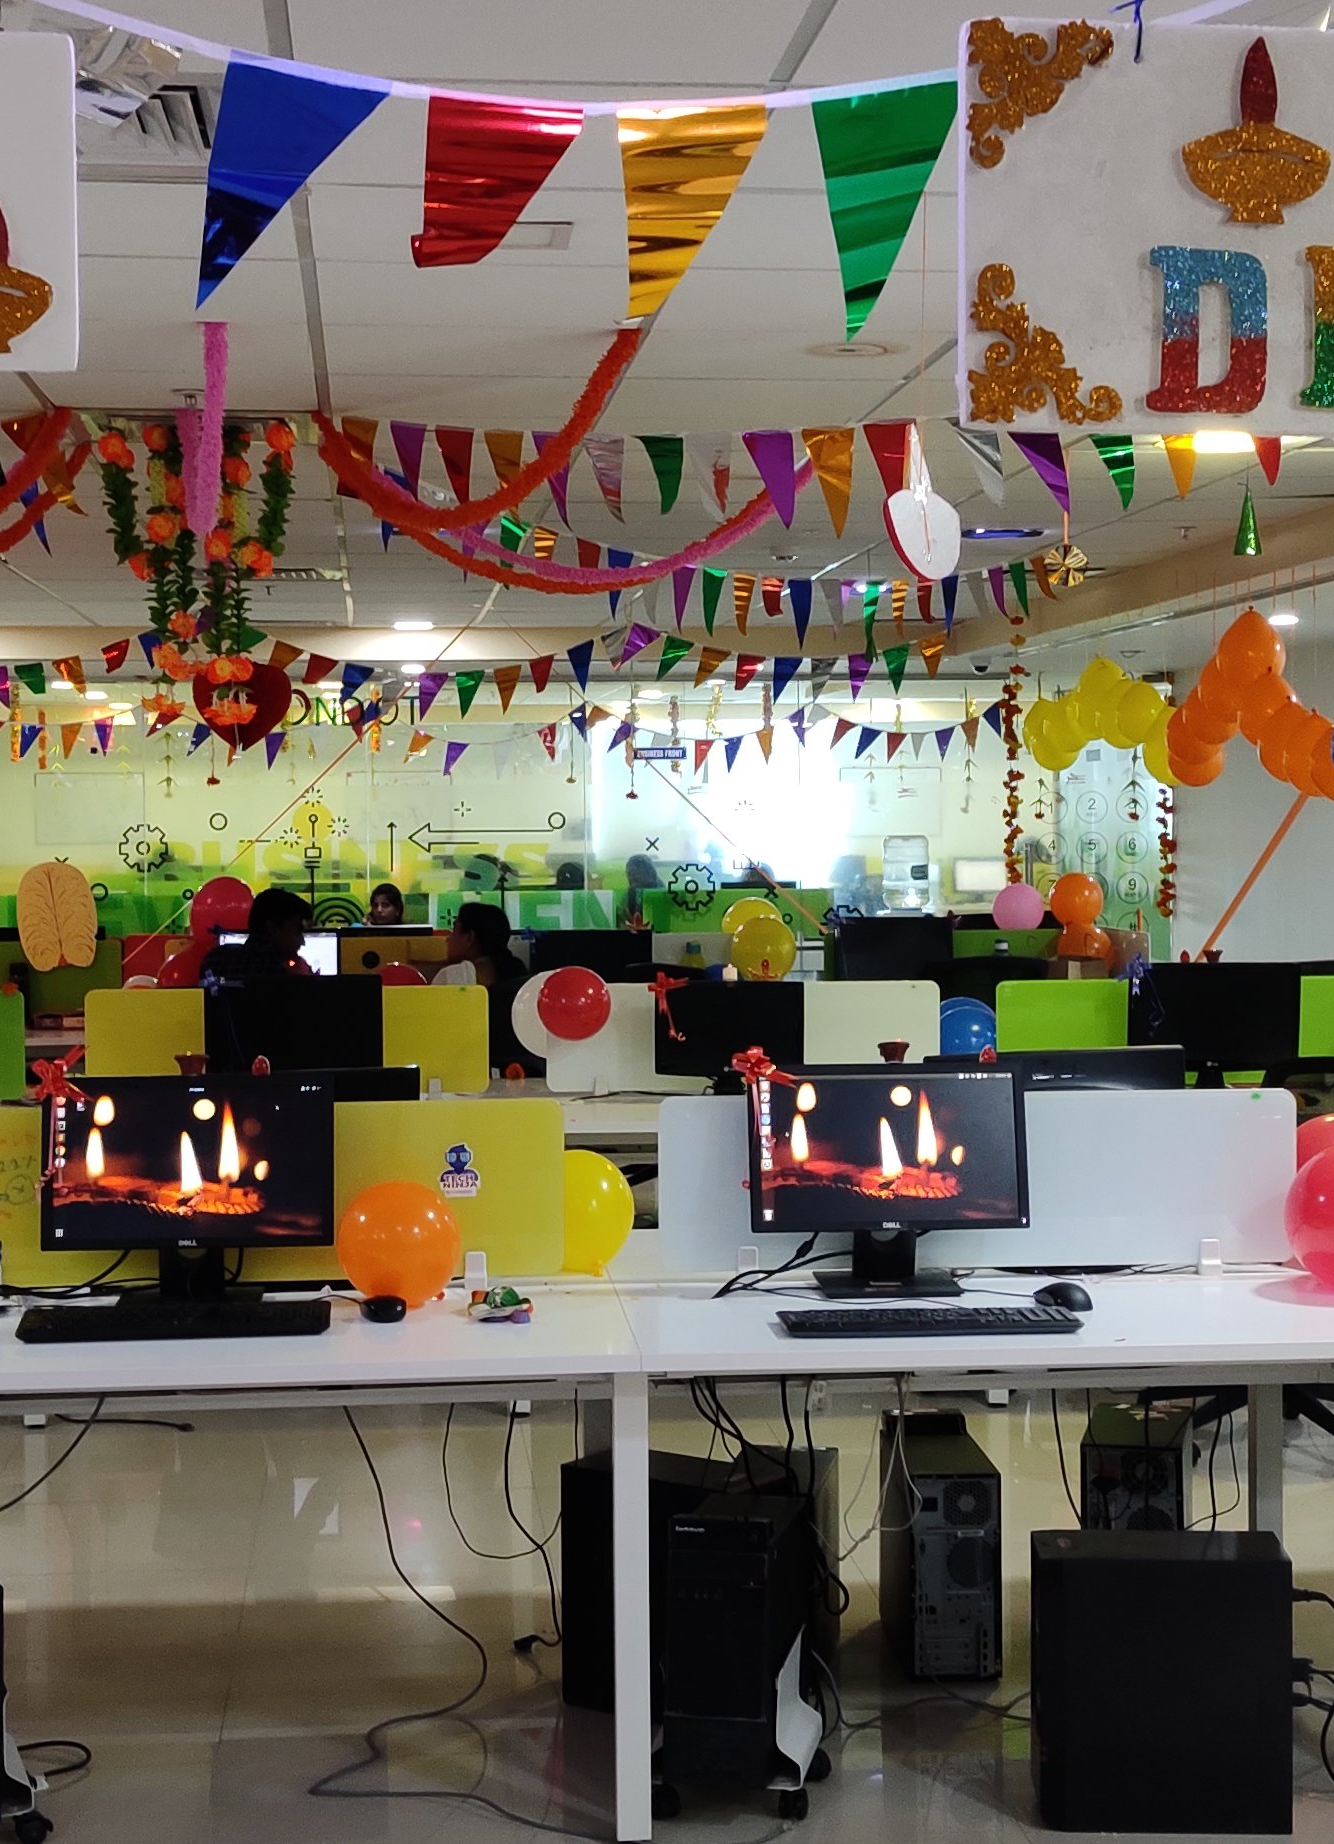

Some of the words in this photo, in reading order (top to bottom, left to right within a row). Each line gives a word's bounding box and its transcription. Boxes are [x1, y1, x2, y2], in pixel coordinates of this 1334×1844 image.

[1087, 797, 1097, 810] 2
[1128, 837, 1137, 851] 6
[1128, 878, 1137, 892] 9
[443, 1174, 475, 1182] TECH
[442, 1181, 478, 1189] NINJA
[882, 1221, 902, 1229] DELL
[178, 1239, 198, 1247] DELL
